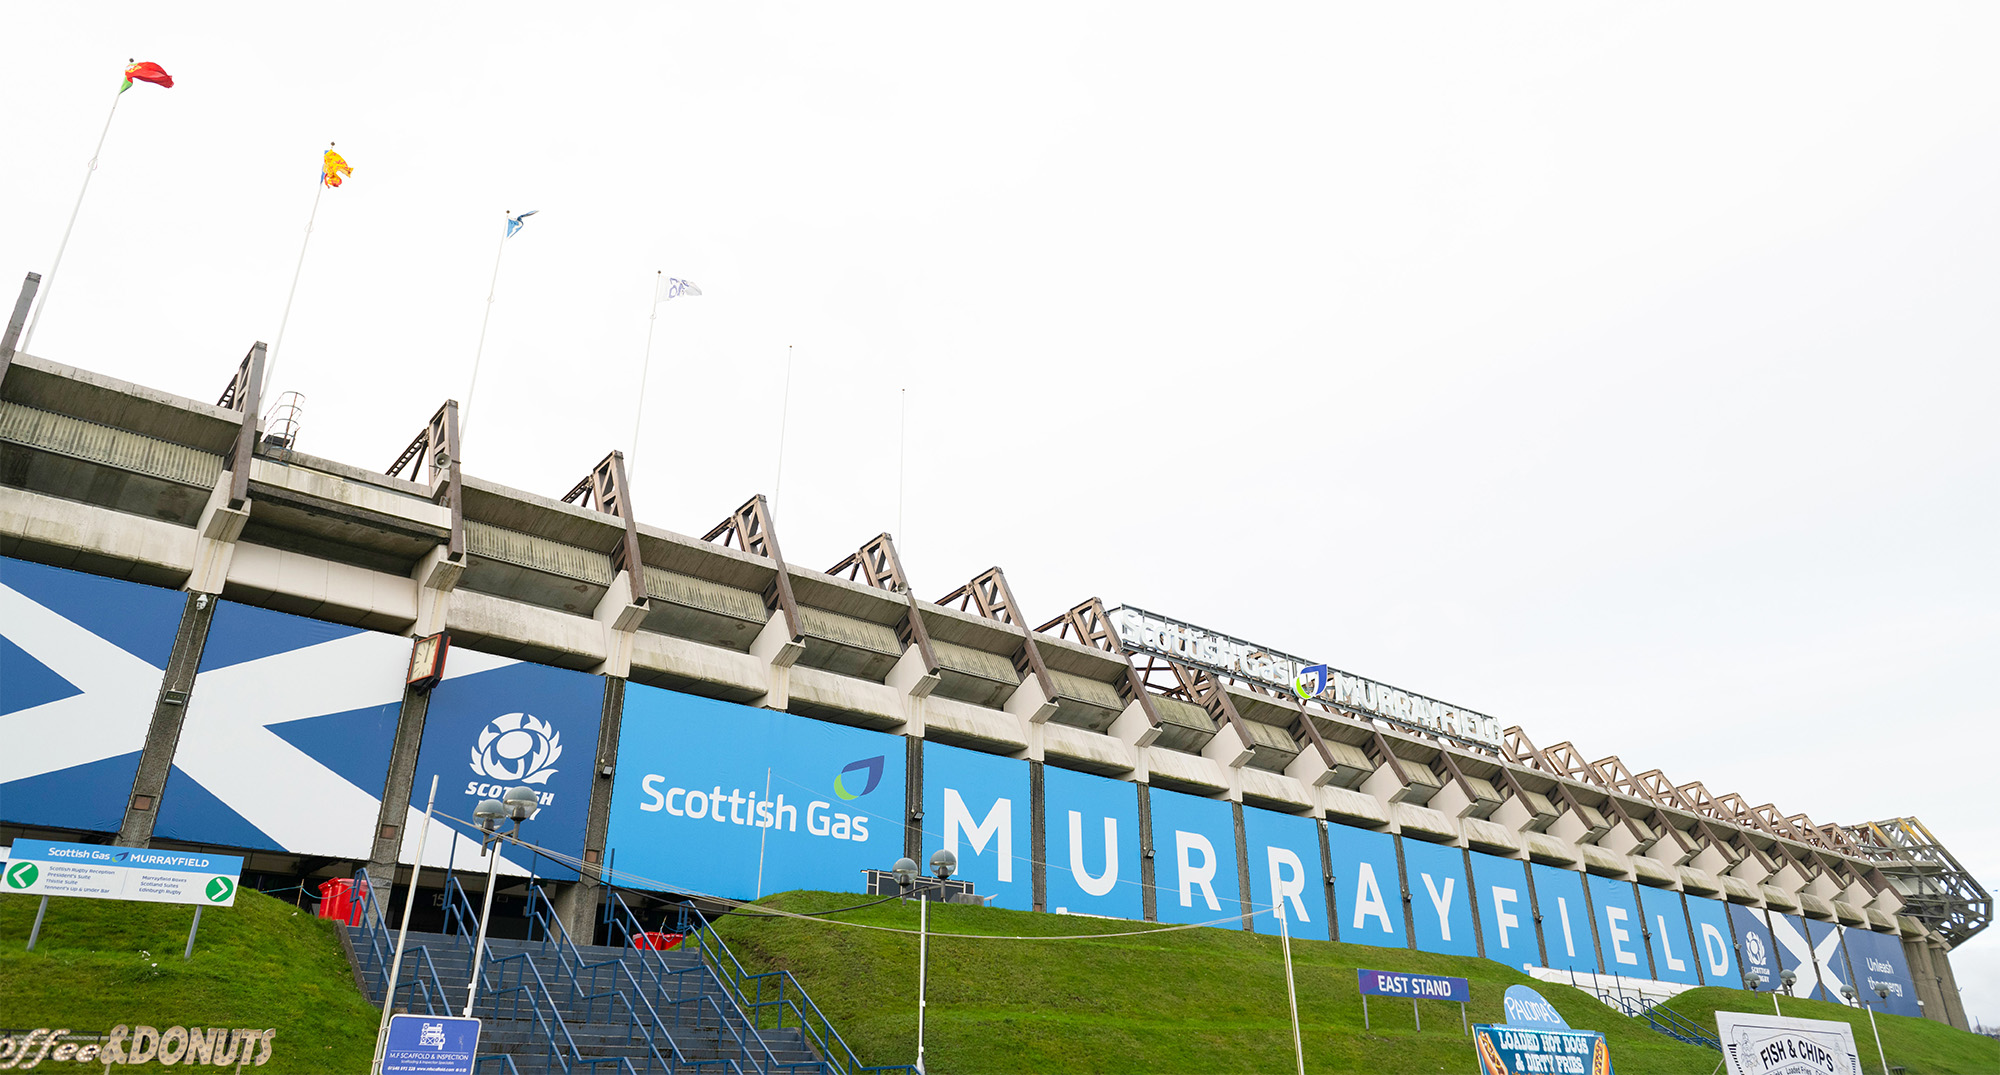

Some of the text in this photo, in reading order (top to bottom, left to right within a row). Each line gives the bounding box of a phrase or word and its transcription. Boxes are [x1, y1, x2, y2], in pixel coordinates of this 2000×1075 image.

[1121, 609, 1504, 746] Scottish Gas MURRAYFIELD
[464, 781, 555, 806] SCOTSH
[640, 773, 869, 842] Scottish Gas
[48, 847, 209, 868] Scottish Gas MURRAYFIELD
[1866, 957, 1894, 974] Unleash
[1378, 974, 1451, 997] EAST STAND
[1504, 997, 1560, 1024] PALOMA'S
[1498, 1031, 1589, 1055] LOADED HOT DOGS
[400, 1052, 430, 1060] SCAFFOLD
[1515, 1052, 1585, 1074] & DIRTY FRIES
[1760, 1039, 1834, 1072] FISH & CHIPS
